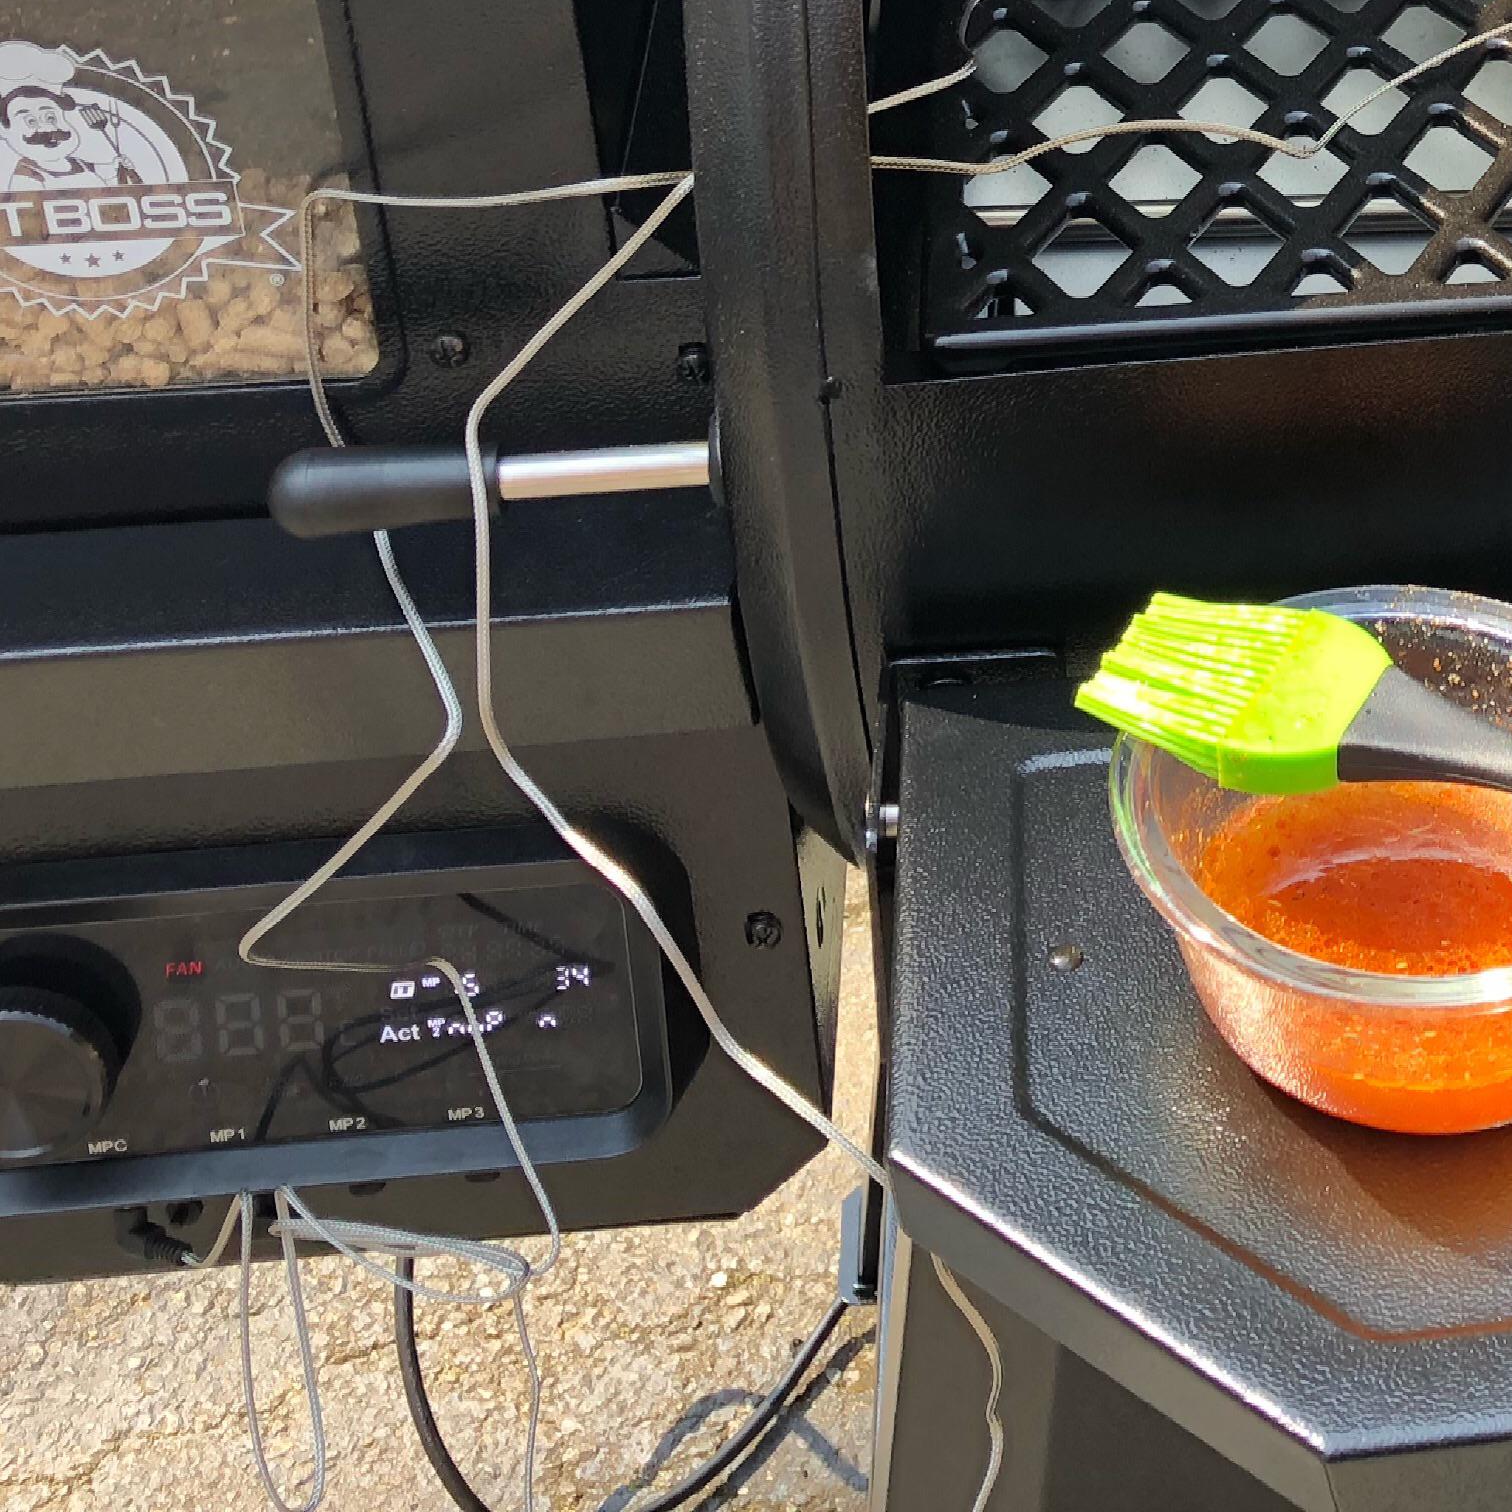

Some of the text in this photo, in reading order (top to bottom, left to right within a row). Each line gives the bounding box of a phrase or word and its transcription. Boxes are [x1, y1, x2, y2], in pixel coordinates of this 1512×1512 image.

[43, 192, 233, 235] BOSS
[165, 961, 204, 978] FAN
[379, 1023, 420, 1043] Act
[447, 1106, 485, 1121] MP 3
[328, 1117, 366, 1133] MP 2
[209, 1127, 245, 1143] MP 1
[88, 1139, 128, 1155] MPC
